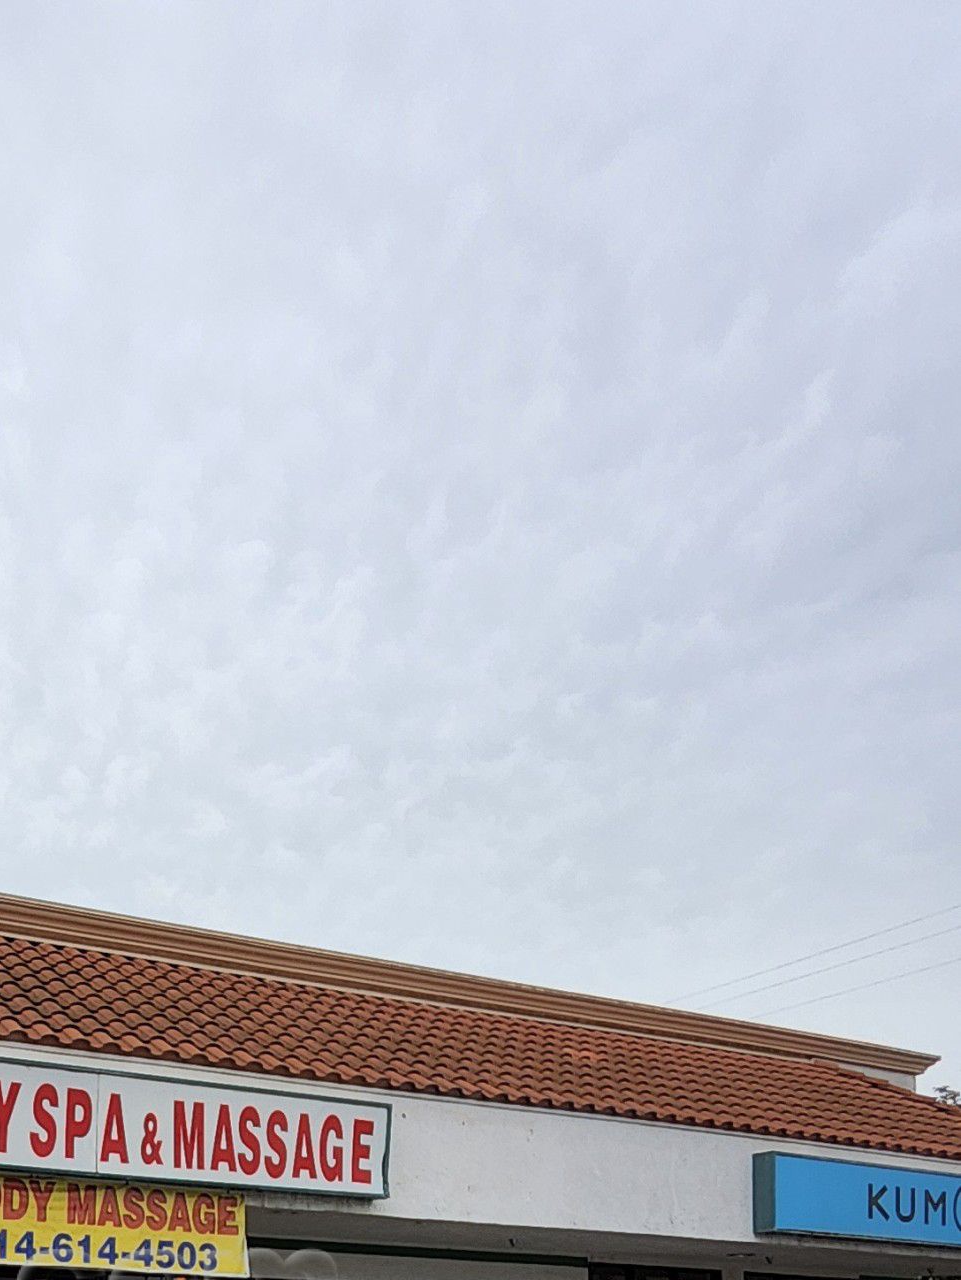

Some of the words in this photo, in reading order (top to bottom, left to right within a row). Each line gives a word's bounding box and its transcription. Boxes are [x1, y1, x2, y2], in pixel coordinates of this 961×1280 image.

[29, 1083, 129, 1164] SPA
[140, 1112, 164, 1165] &
[173, 1100, 375, 1185] MASSAGE
[67, 1182, 240, 1236] MASSAGE
[867, 1183, 961, 1231] KUM
